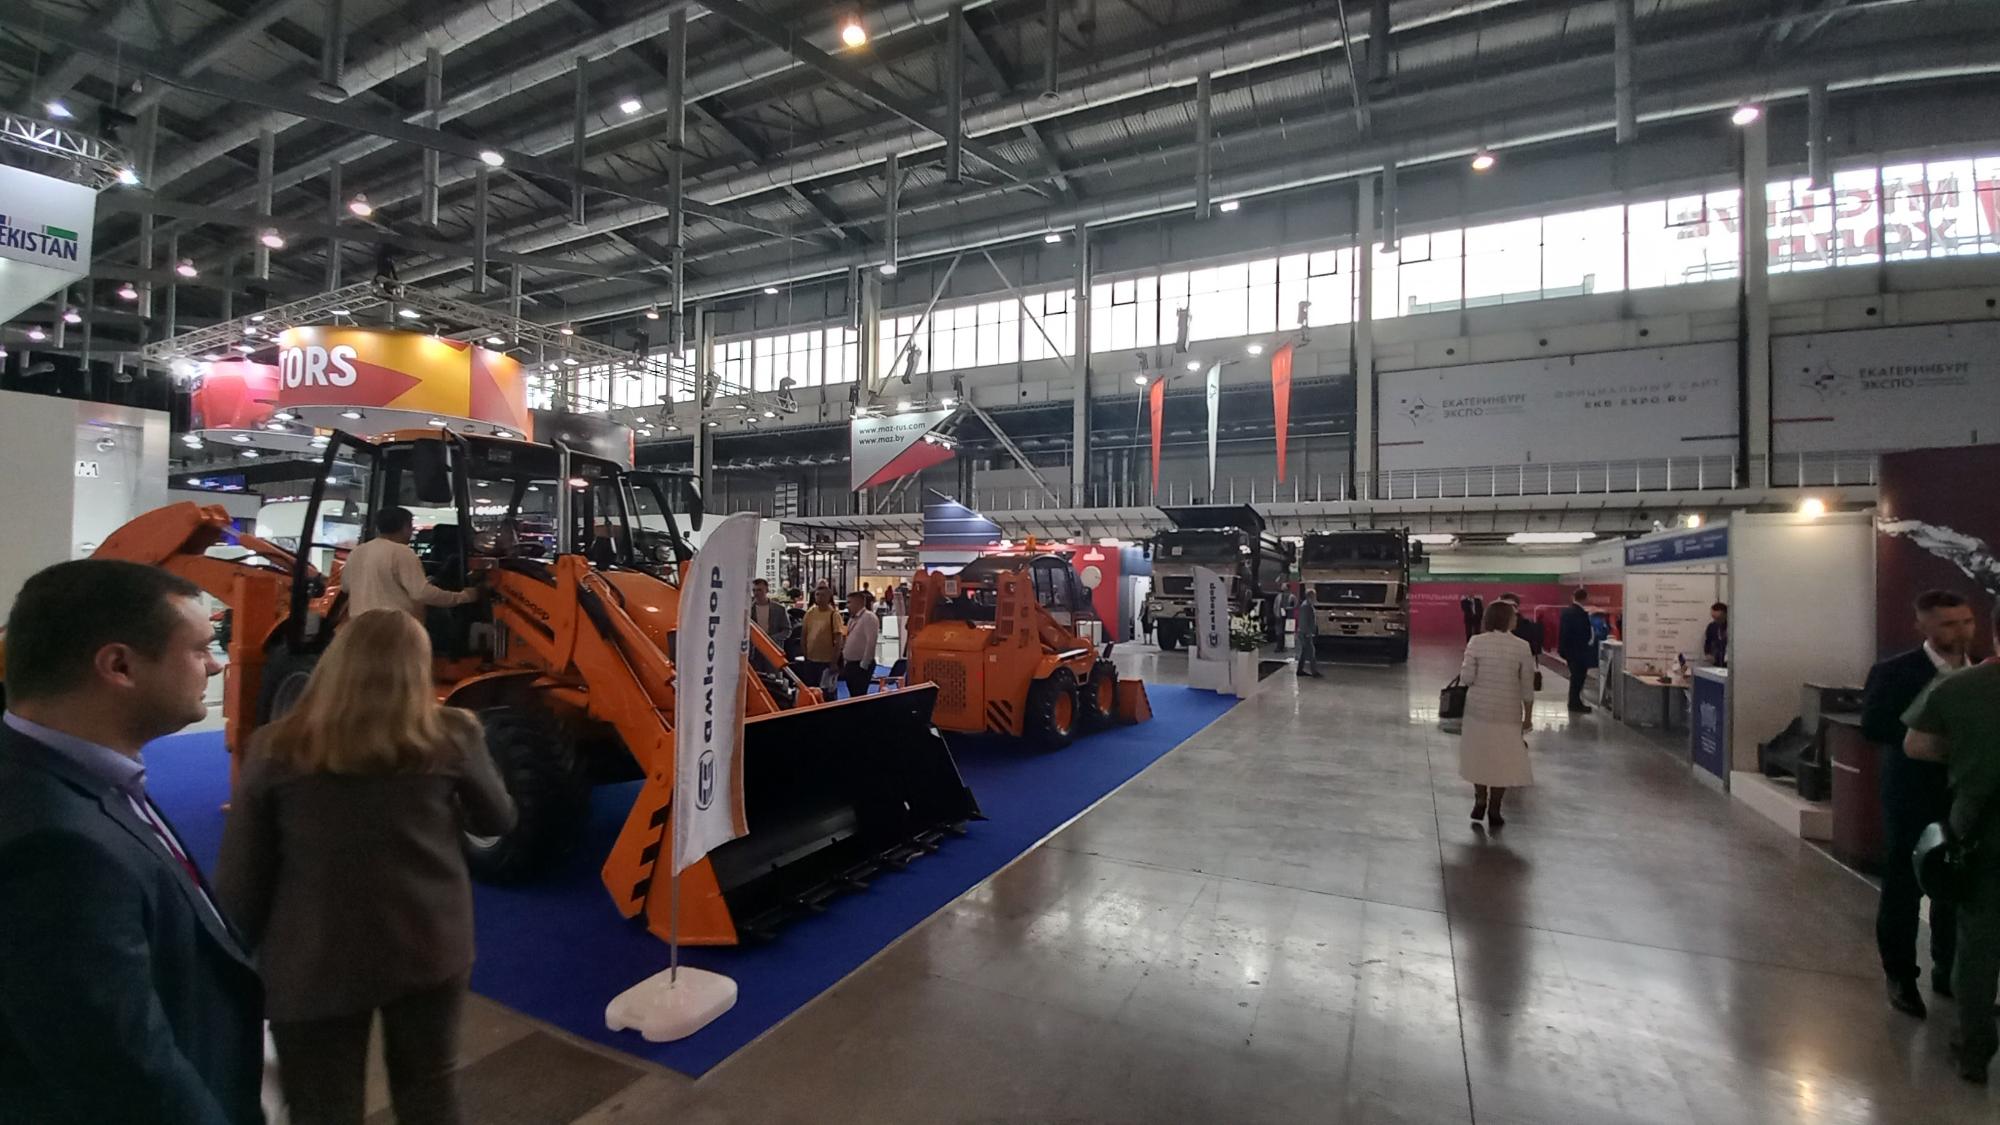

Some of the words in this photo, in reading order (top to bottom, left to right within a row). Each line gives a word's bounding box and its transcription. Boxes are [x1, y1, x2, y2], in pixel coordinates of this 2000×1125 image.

[0, 225, 78, 261] EKISTAN
[1859, 361, 1970, 379] ЕКАТЕРИНБУРГ
[1554, 381, 1672, 399] ОФИЦИАЛЬНЫЙ
[1680, 377, 1719, 390] САЙТ
[1861, 377, 1914, 390] ЭКСПО
[1442, 393, 1527, 409] ЕКАТЕРИНБУРГ
[1443, 407, 1484, 419] ЭКСПО
[859, 422, 926, 435] www.maz-rus.com
[859, 434, 905, 445] www.maz.by
